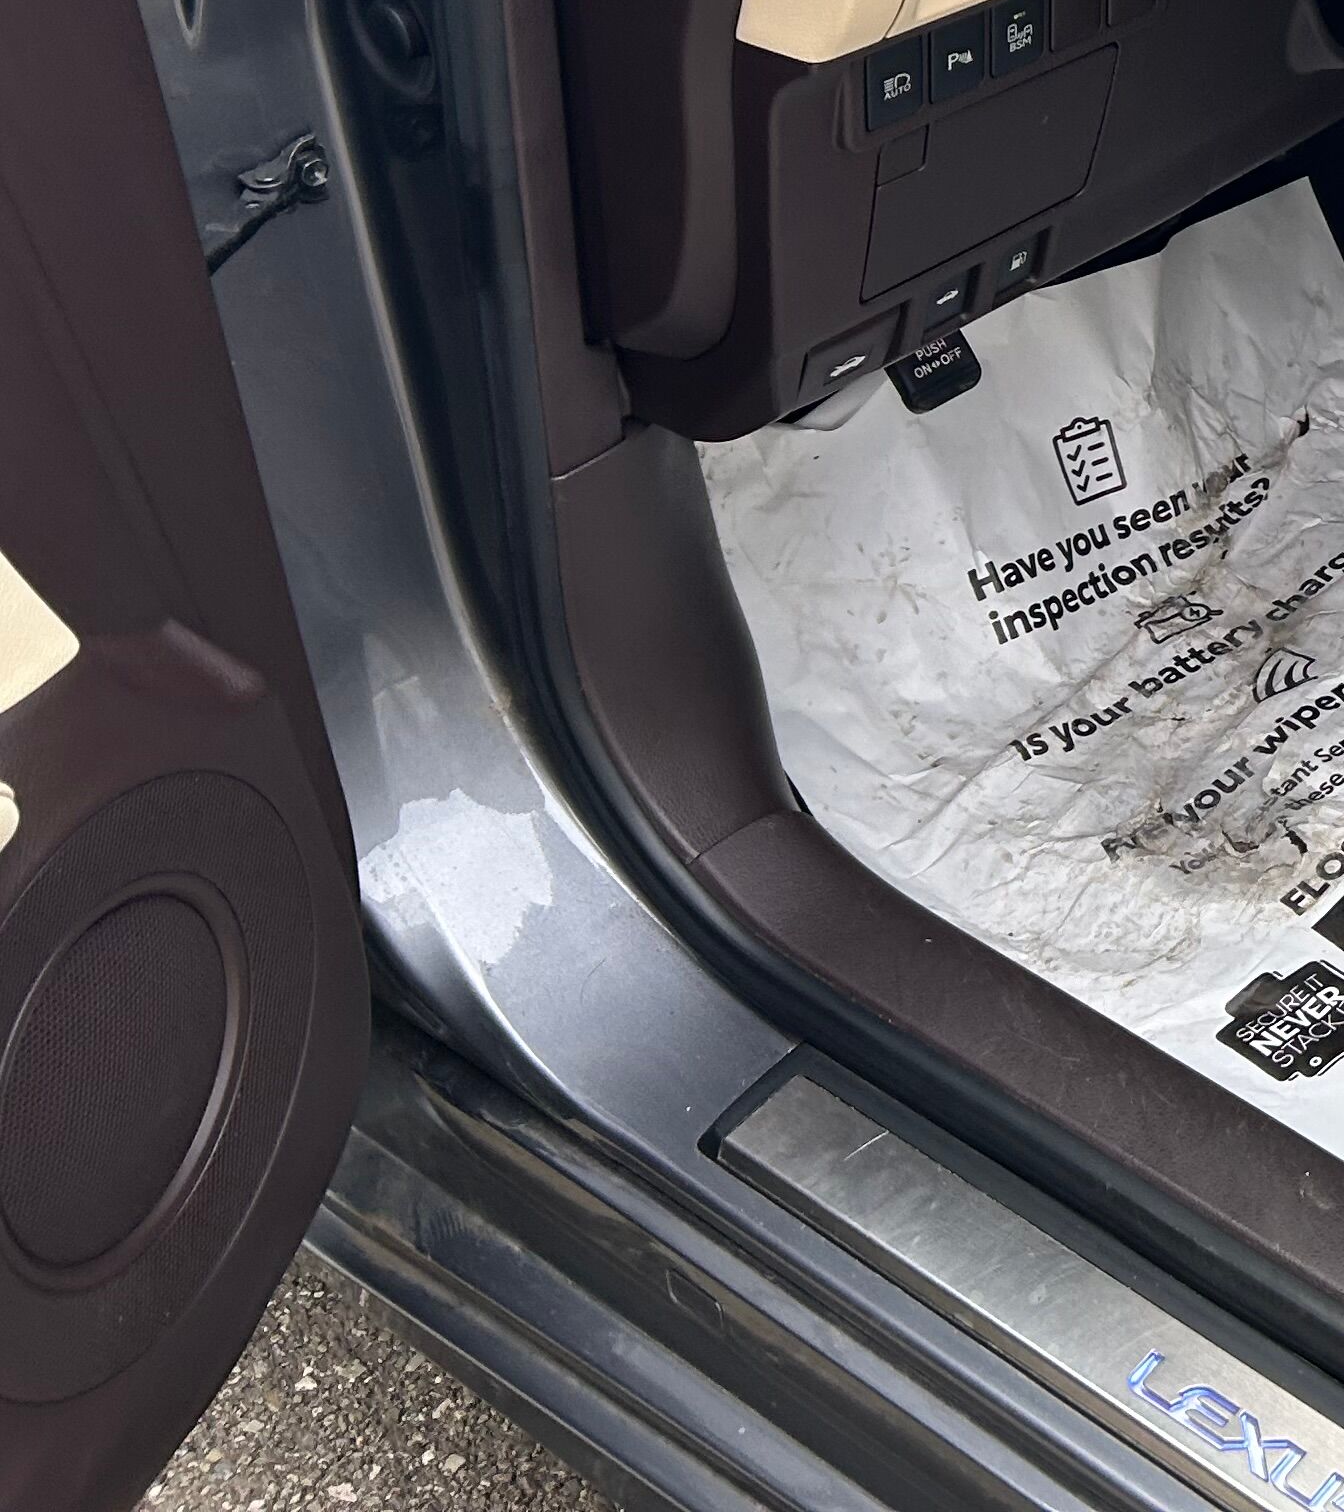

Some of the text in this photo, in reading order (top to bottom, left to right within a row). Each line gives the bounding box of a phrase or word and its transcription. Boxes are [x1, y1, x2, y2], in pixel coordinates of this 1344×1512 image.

[1009, 36, 1032, 53] BSM
[883, 83, 912, 101] AUTO
[915, 337, 948, 362] PUSH
[967, 546, 1056, 602] Have
[1055, 523, 1112, 573] you
[1112, 489, 1191, 541] seen
[988, 551, 1159, 645] inspection
[1006, 730, 1049, 762] Is
[1049, 694, 1134, 754] your
[1128, 618, 1264, 700] battery
[1235, 972, 1324, 1043] SECURE IT
